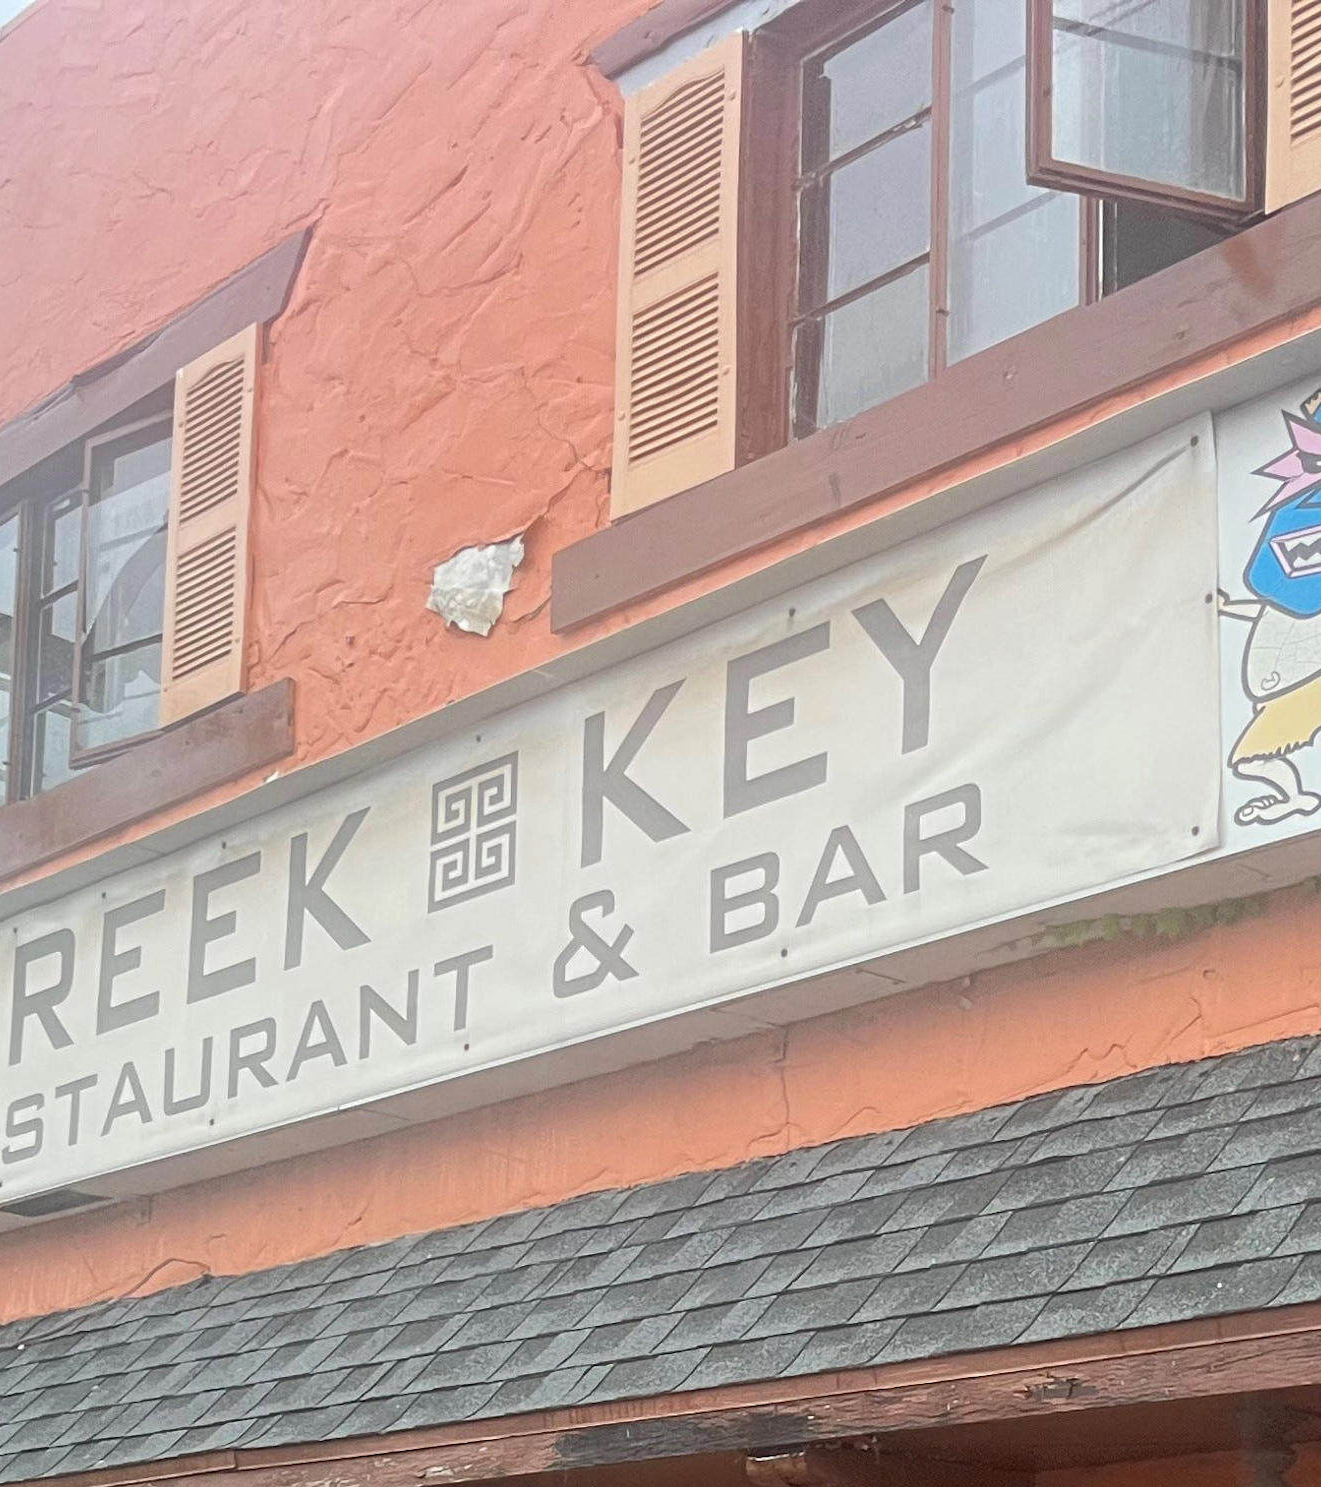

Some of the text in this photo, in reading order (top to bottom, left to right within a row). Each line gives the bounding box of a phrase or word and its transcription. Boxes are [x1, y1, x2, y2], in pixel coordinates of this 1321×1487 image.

[579, 554, 988, 868] KEY
[552, 889, 637, 1000] &
[709, 782, 988, 954] BAR
